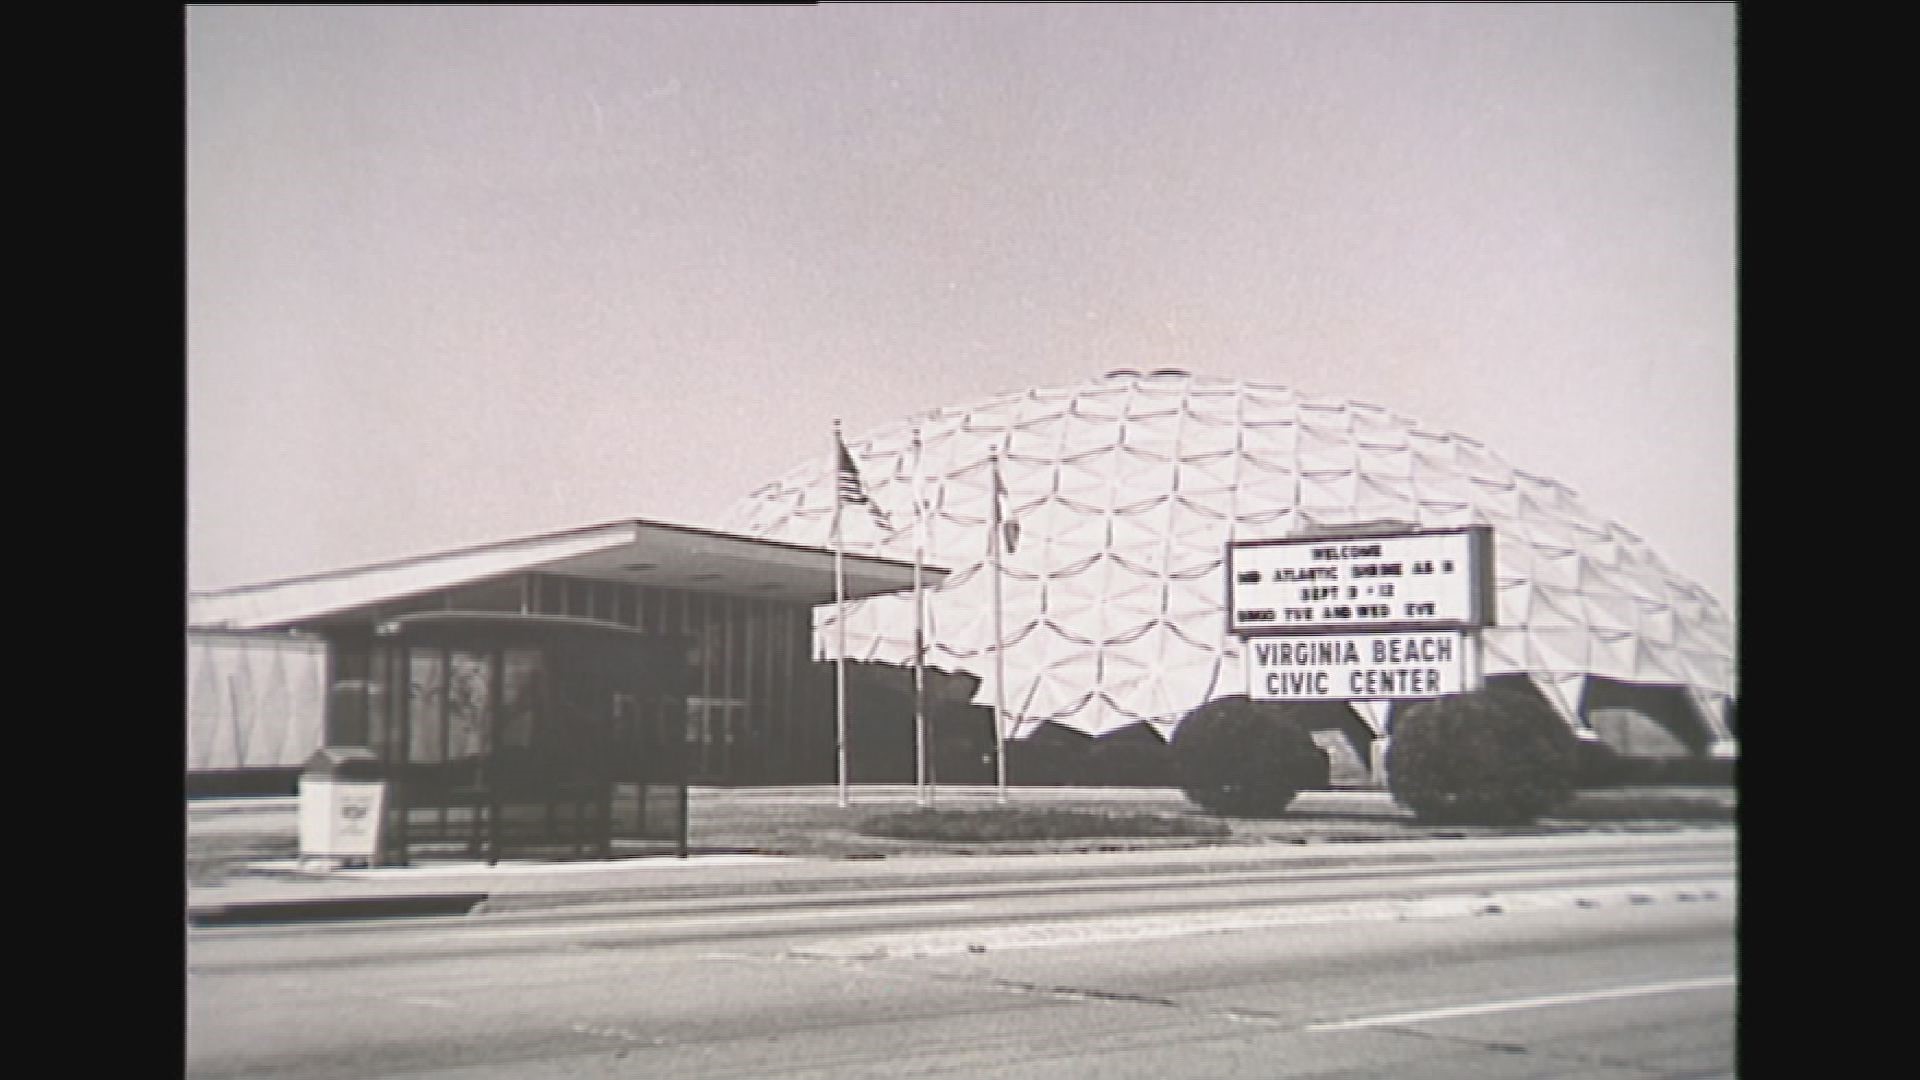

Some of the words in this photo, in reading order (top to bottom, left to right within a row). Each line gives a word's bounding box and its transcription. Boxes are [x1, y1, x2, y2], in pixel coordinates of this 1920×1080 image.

[1255, 641, 1361, 666] VIRGINIA
[1372, 637, 1452, 664] BEACH
[1267, 671, 1329, 695] CIVIC
[1350, 669, 1441, 694] CENTER
